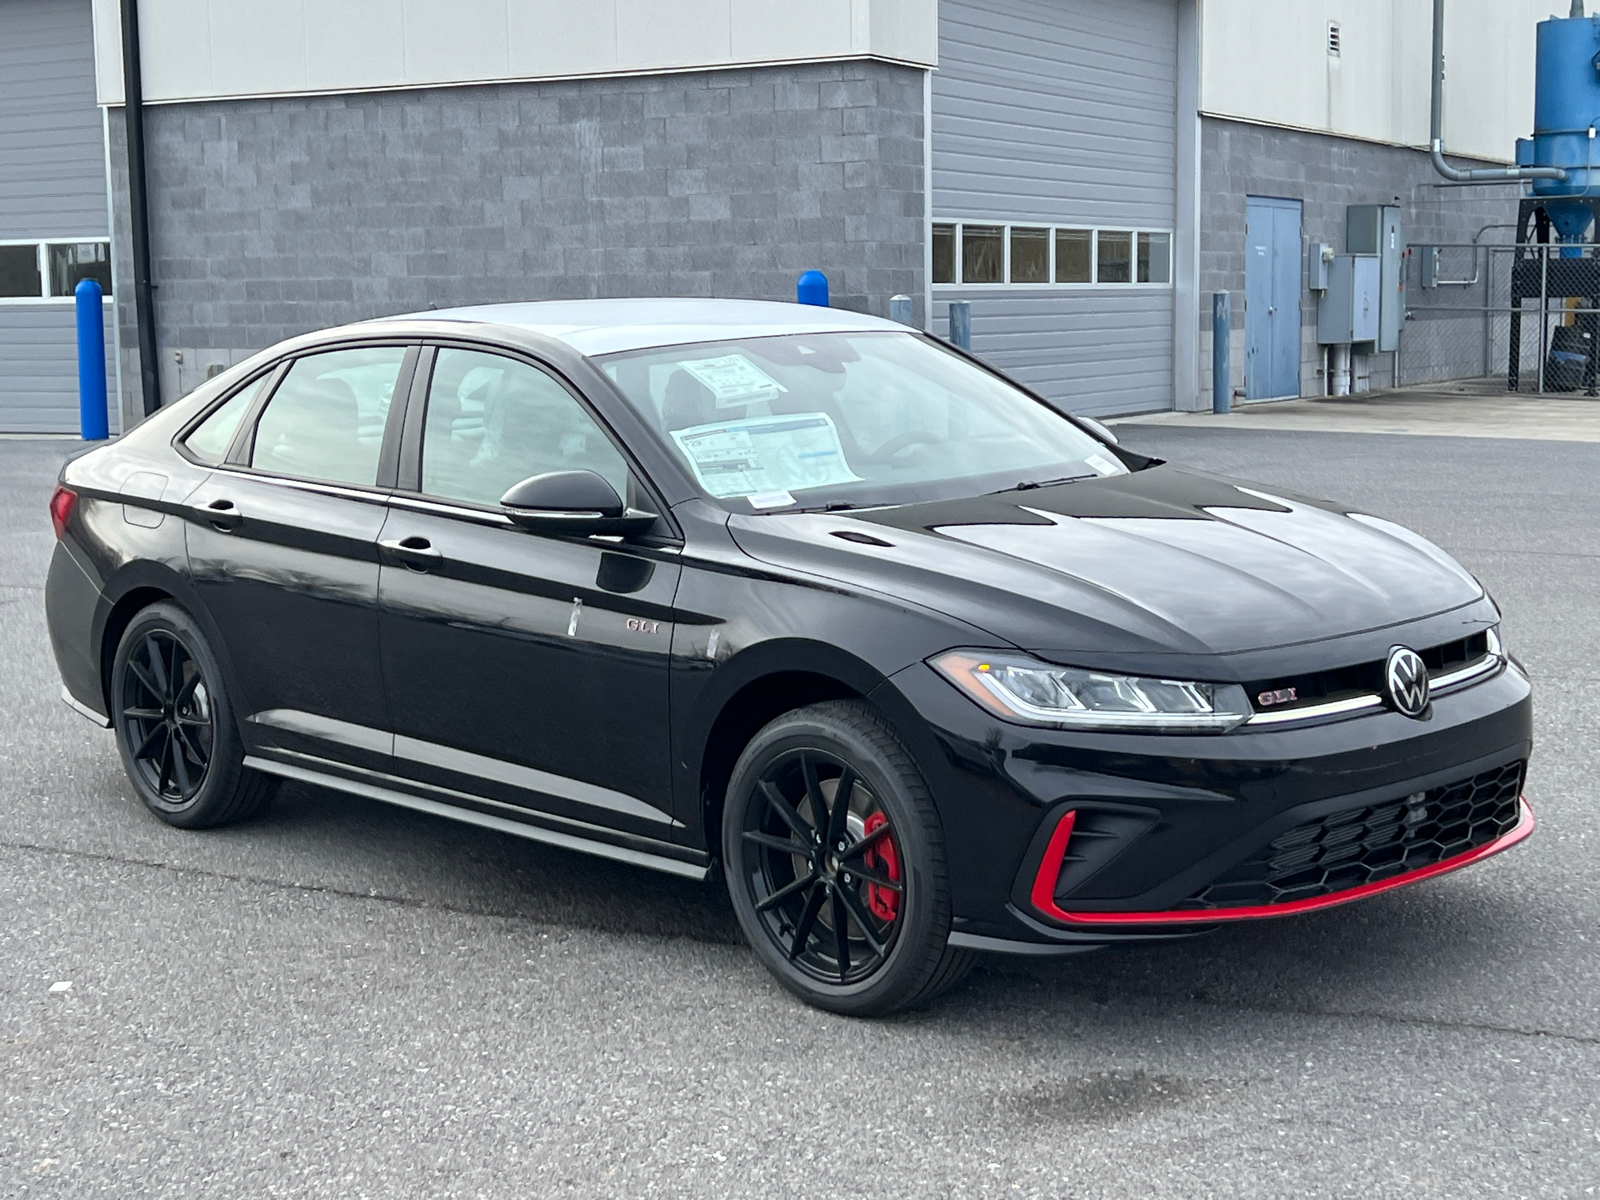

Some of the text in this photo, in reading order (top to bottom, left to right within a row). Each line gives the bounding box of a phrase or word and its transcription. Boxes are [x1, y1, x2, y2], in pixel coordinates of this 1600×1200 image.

[626, 618, 660, 634] GLI
[1391, 651, 1428, 712] VW
[1257, 687, 1298, 706] GLI
